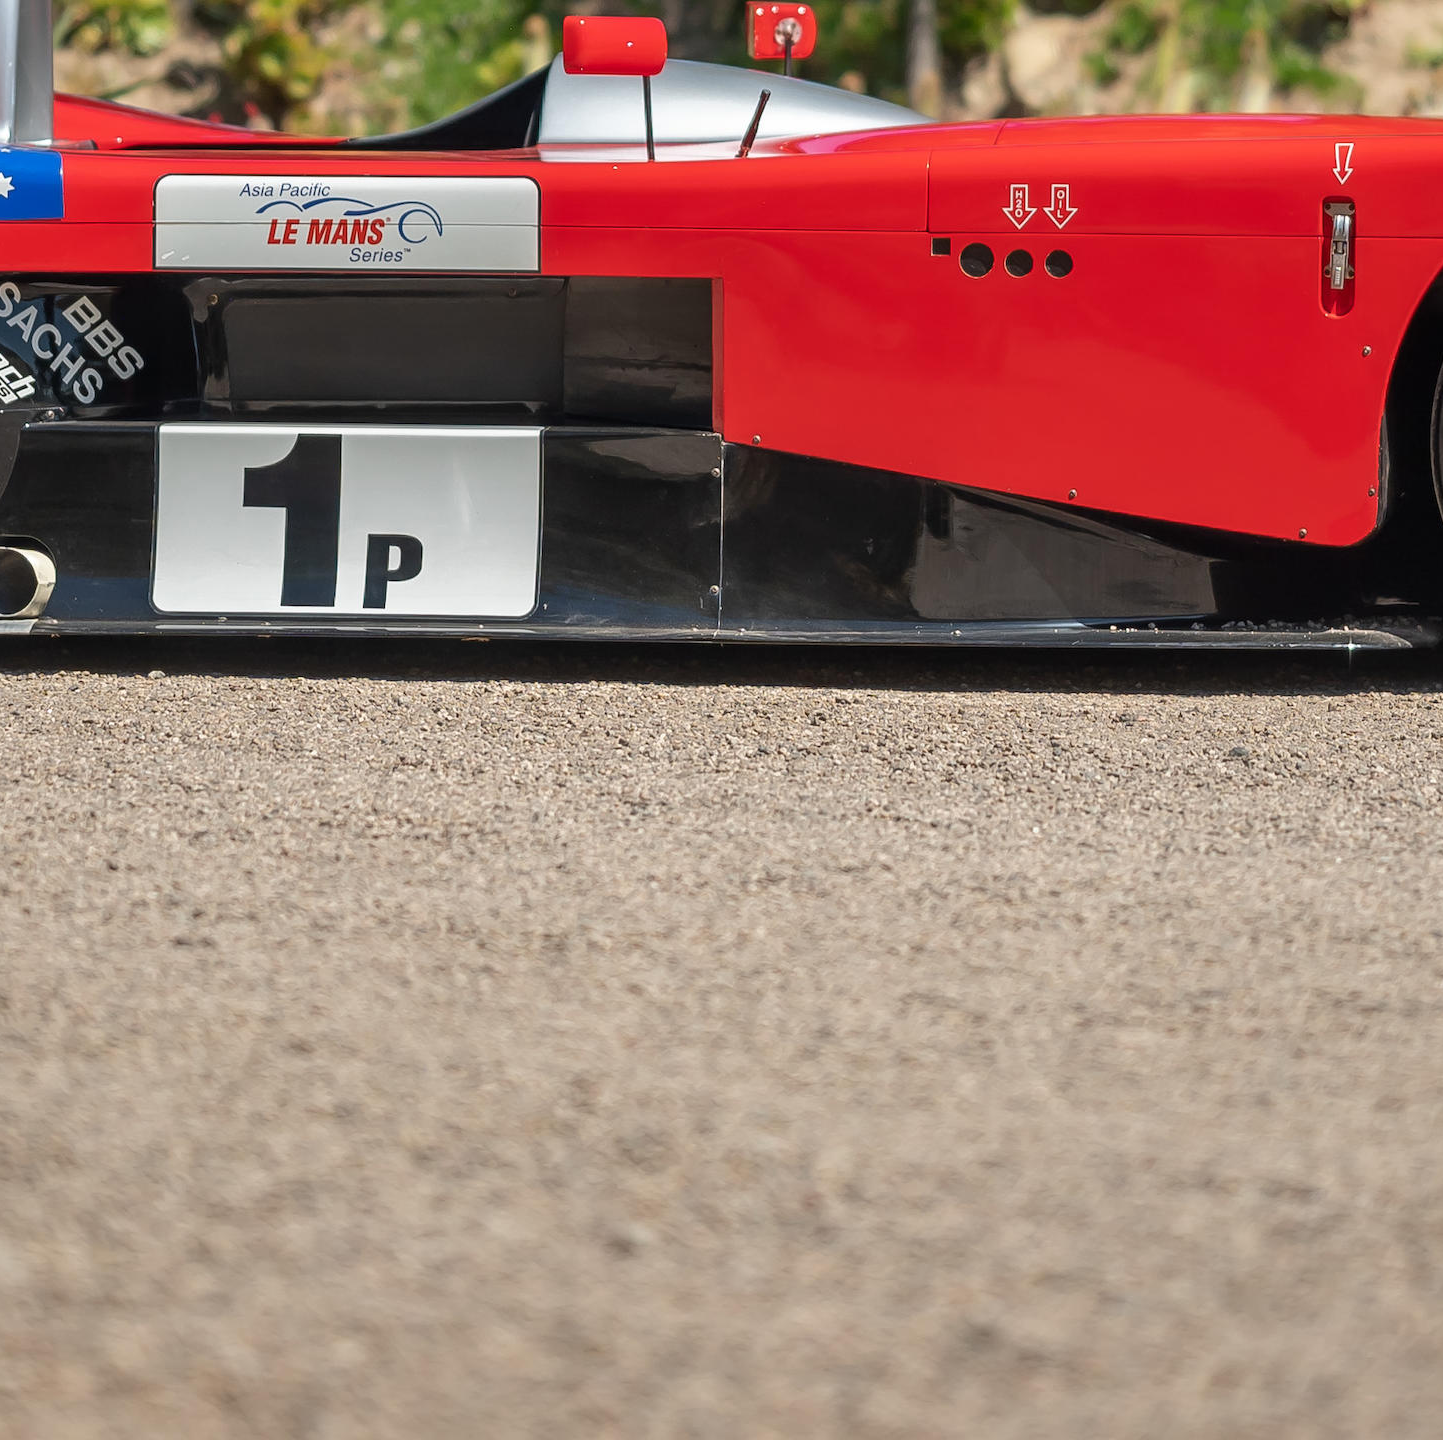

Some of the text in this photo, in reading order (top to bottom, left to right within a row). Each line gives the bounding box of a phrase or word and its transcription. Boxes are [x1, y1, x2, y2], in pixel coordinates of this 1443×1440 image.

[239, 182, 331, 197] Asia Pacific
[1014, 190, 1024, 218] H2O
[1056, 190, 1065, 218] OIL
[267, 218, 300, 245] LE
[61, 295, 145, 381] BBS
[242, 433, 343, 607] 1
